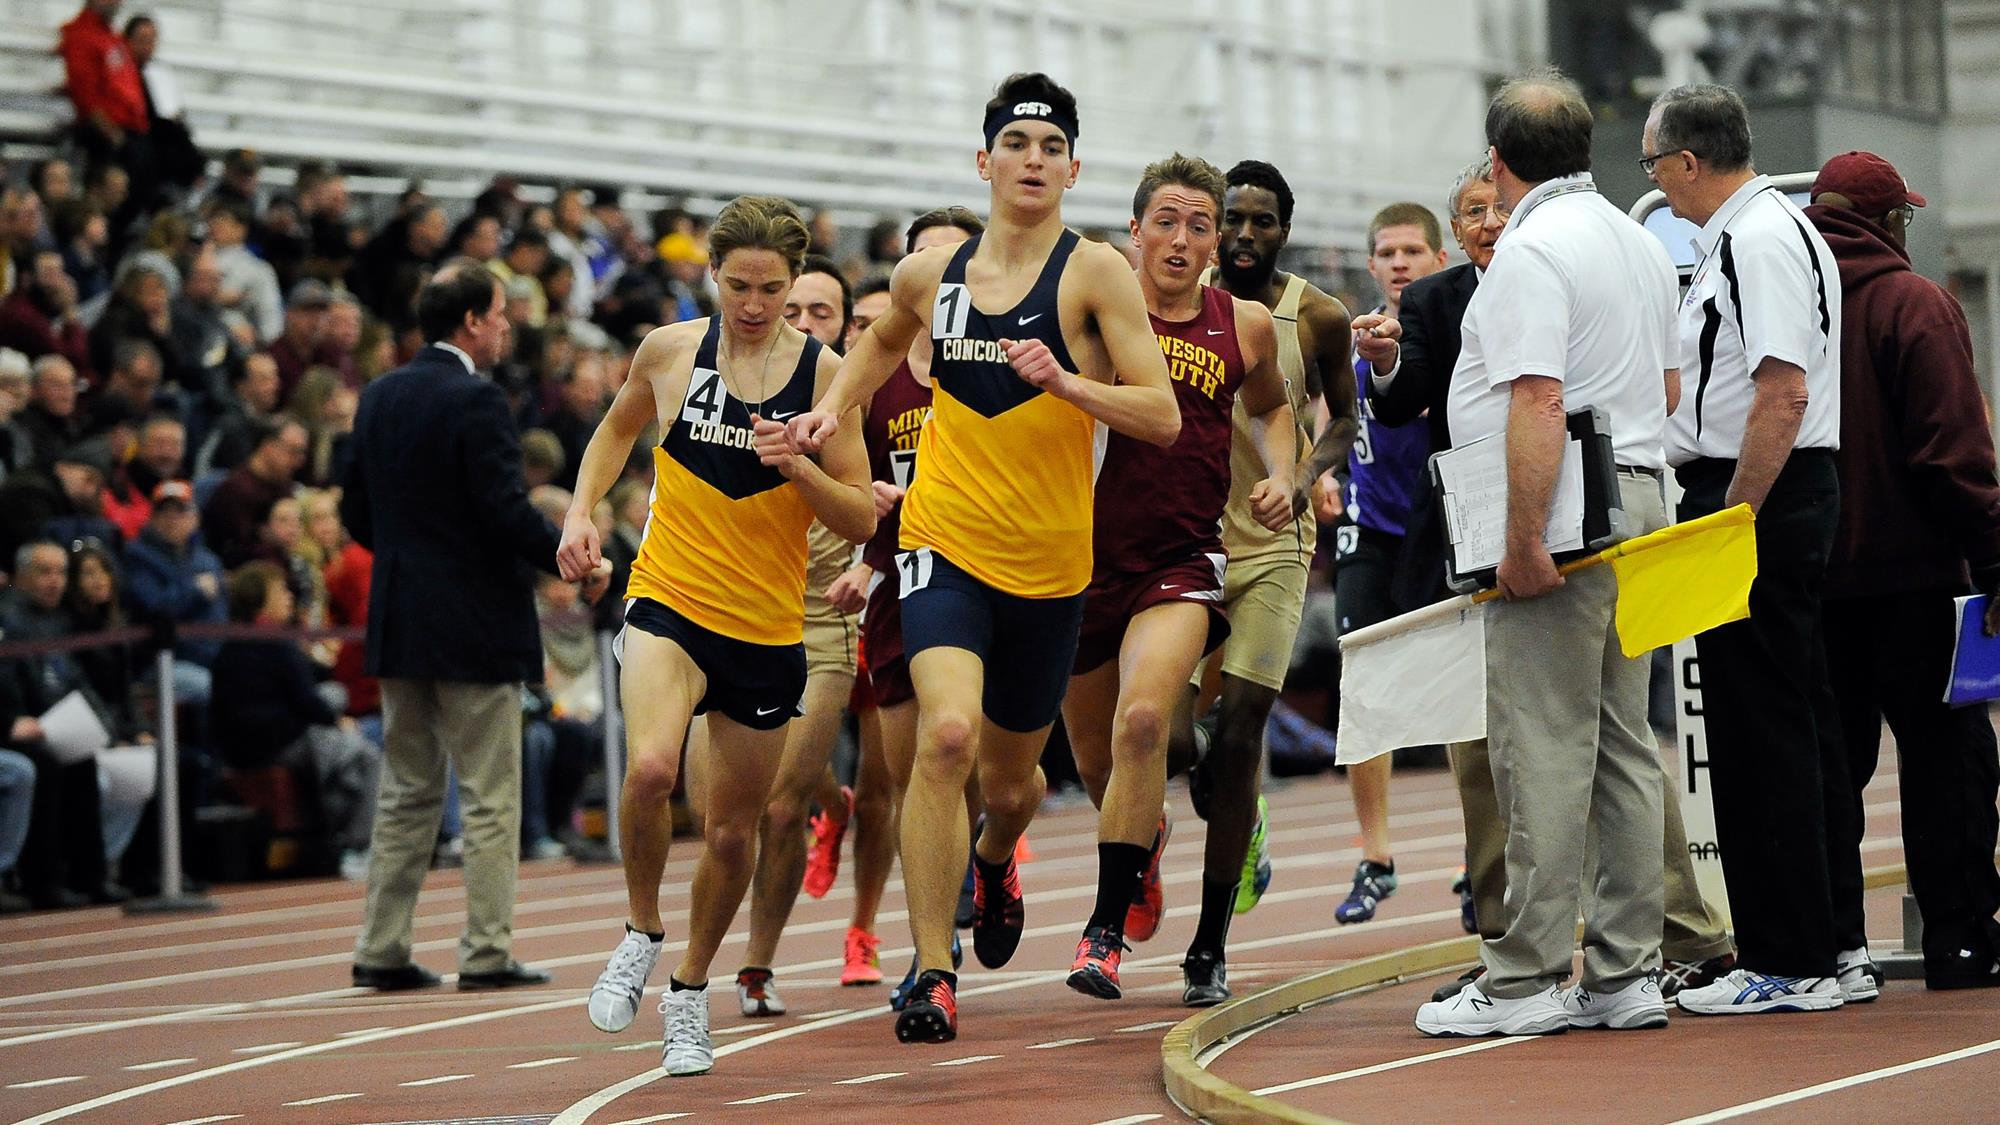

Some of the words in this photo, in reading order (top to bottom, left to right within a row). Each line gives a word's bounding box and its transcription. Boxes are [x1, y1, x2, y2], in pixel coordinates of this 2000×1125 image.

[1013, 102, 1052, 116] CSP
[939, 286, 961, 333] 1
[943, 338, 1026, 364] CONCOR
[1153, 334, 1225, 385] NESOTA
[687, 373, 720, 421] 4
[888, 406, 931, 439] MIN
[895, 452, 917, 490] 7
[902, 543, 919, 588] 1
